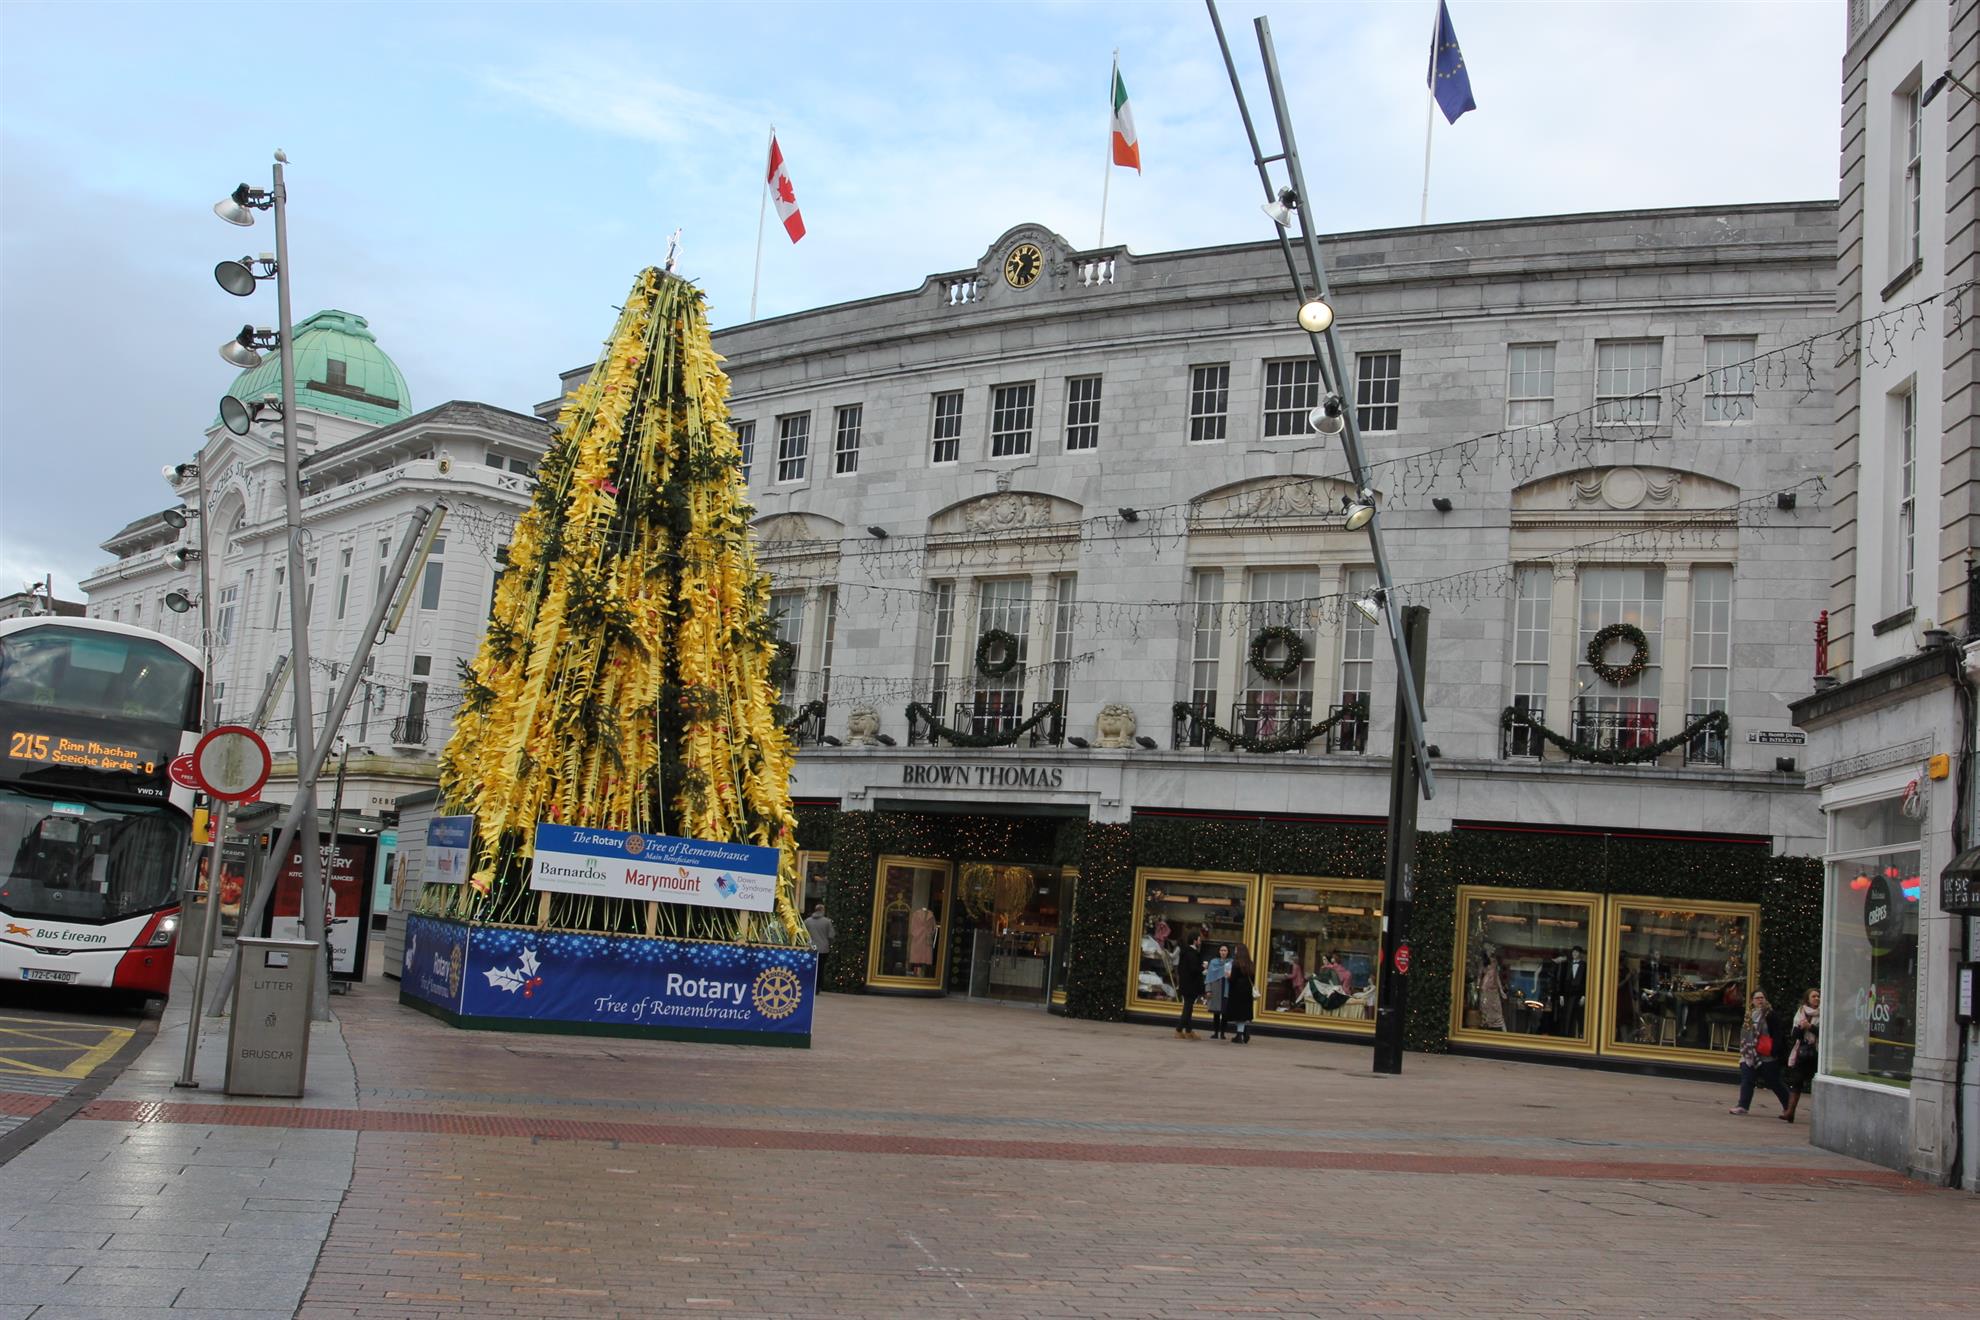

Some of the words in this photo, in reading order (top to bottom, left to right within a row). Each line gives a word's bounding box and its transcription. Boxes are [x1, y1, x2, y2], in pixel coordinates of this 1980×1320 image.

[9, 732, 50, 760] 215
[58, 738, 85, 752] Rinn
[88, 742, 138, 759] Mhachan
[51, 750, 99, 766] Sceiche
[902, 765, 970, 785] BROWN
[975, 767, 1063, 788] THOMAS
[137, 787, 154, 796] VWD
[154, 788, 163, 797] 74
[572, 831, 592, 844] The
[592, 835, 624, 849] Rotary
[646, 839, 667, 852] Tree
[667, 842, 681, 857] of
[680, 845, 750, 862] Remembrance
[293, 854, 353, 868] DVERY
[644, 852, 663, 861] Main
[663, 854, 700, 865] Beneficiaries
[540, 861, 607, 881] Barnardos
[625, 868, 701, 893] Marymount
[737, 875, 757, 884] Down
[738, 892, 755, 900] Cork
[742, 884, 773, 894] Syndrome
[36, 928, 60, 940] Bus
[254, 981, 294, 991] LITTER
[666, 973, 747, 1005] Rotary
[594, 994, 628, 1012] Tree
[631, 997, 650, 1021] of
[650, 1000, 751, 1020] Remembrance
[241, 1049, 294, 1059] BRUSCAR
